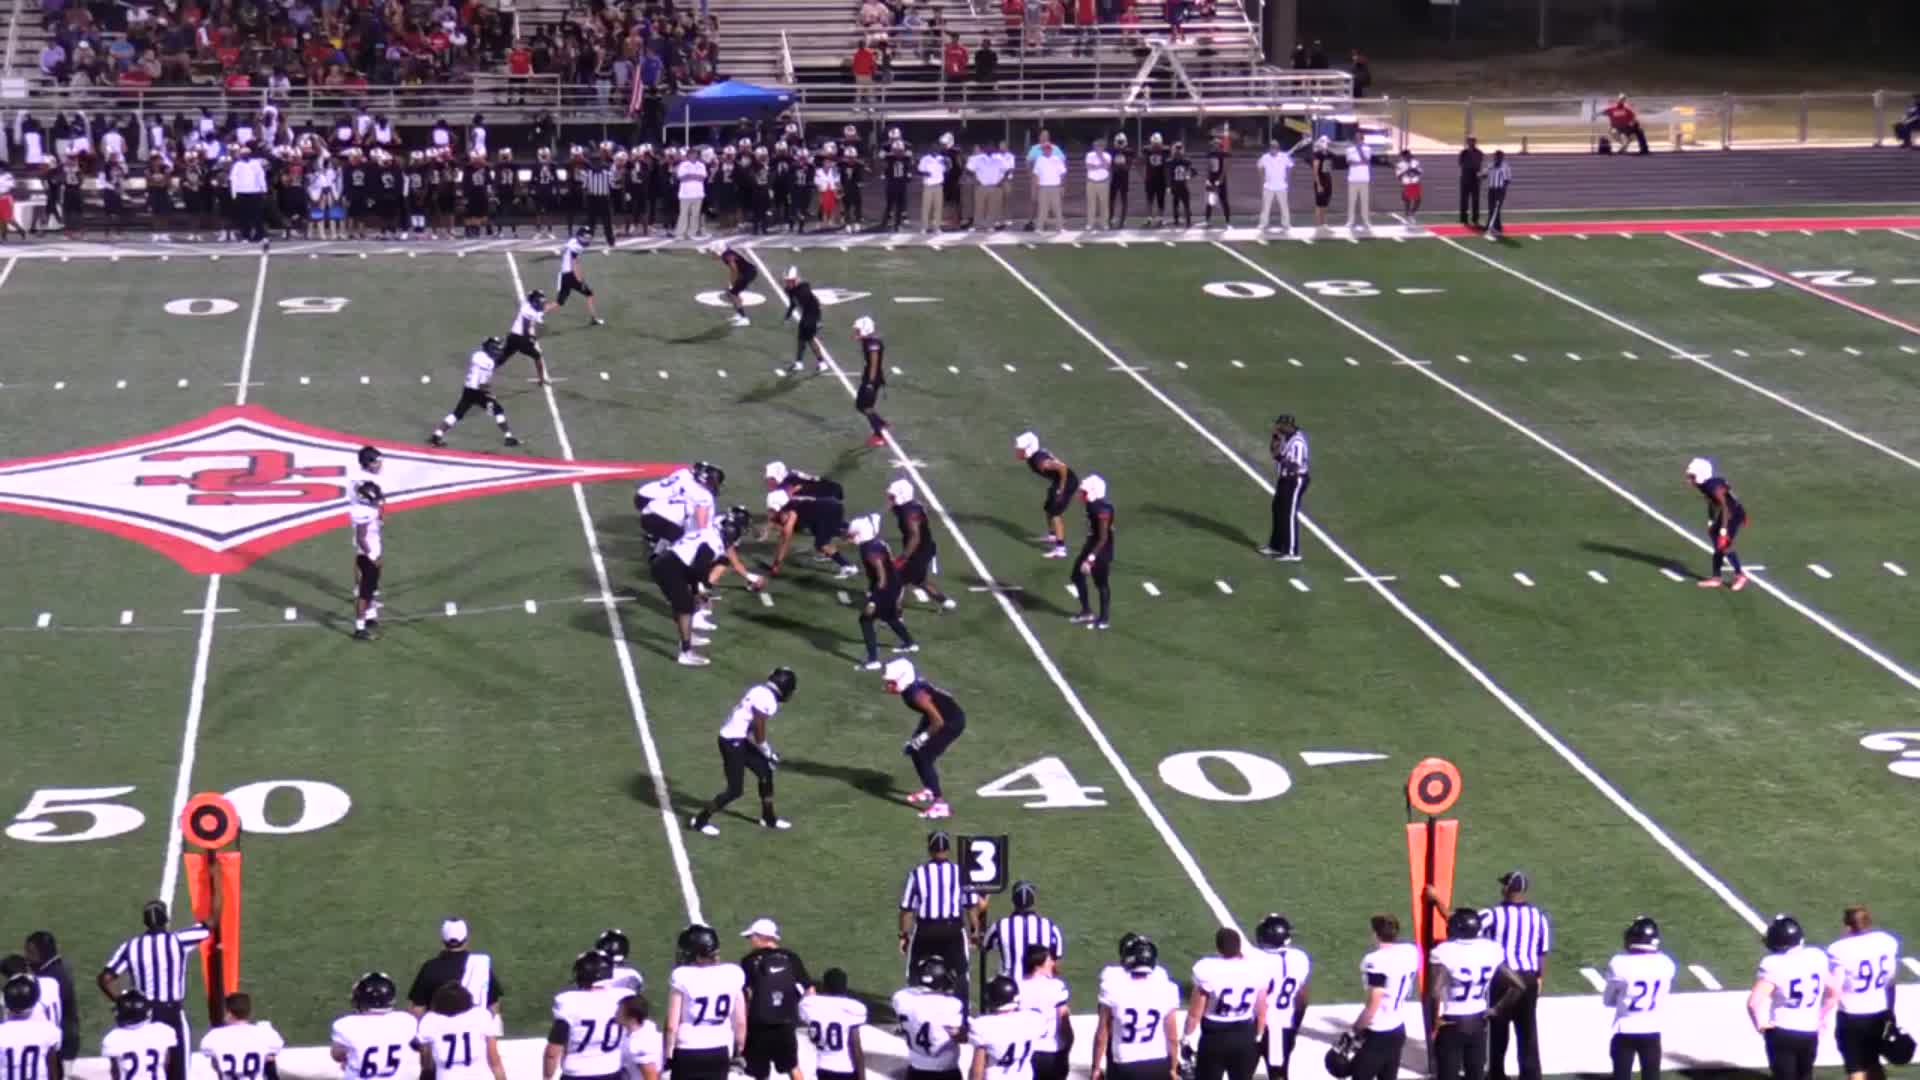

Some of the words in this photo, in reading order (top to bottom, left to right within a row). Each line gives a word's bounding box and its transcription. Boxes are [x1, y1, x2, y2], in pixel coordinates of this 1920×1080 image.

[1202, 280, 1382, 298] 30
[1697, 269, 1876, 289] 20
[163, 296, 350, 316] 50
[976, 751, 1292, 811] 40
[5, 780, 351, 842] 50
[968, 841, 997, 883] 3
[1627, 980, 1661, 1011] 21
[1786, 973, 1820, 1008] 53
[692, 994, 730, 1026] 79
[1120, 1007, 1161, 1043] 33
[443, 1032, 472, 1069] 71
[576, 1017, 623, 1053] 70
[360, 1044, 401, 1079] 65
[996, 1040, 1032, 1075] 41
